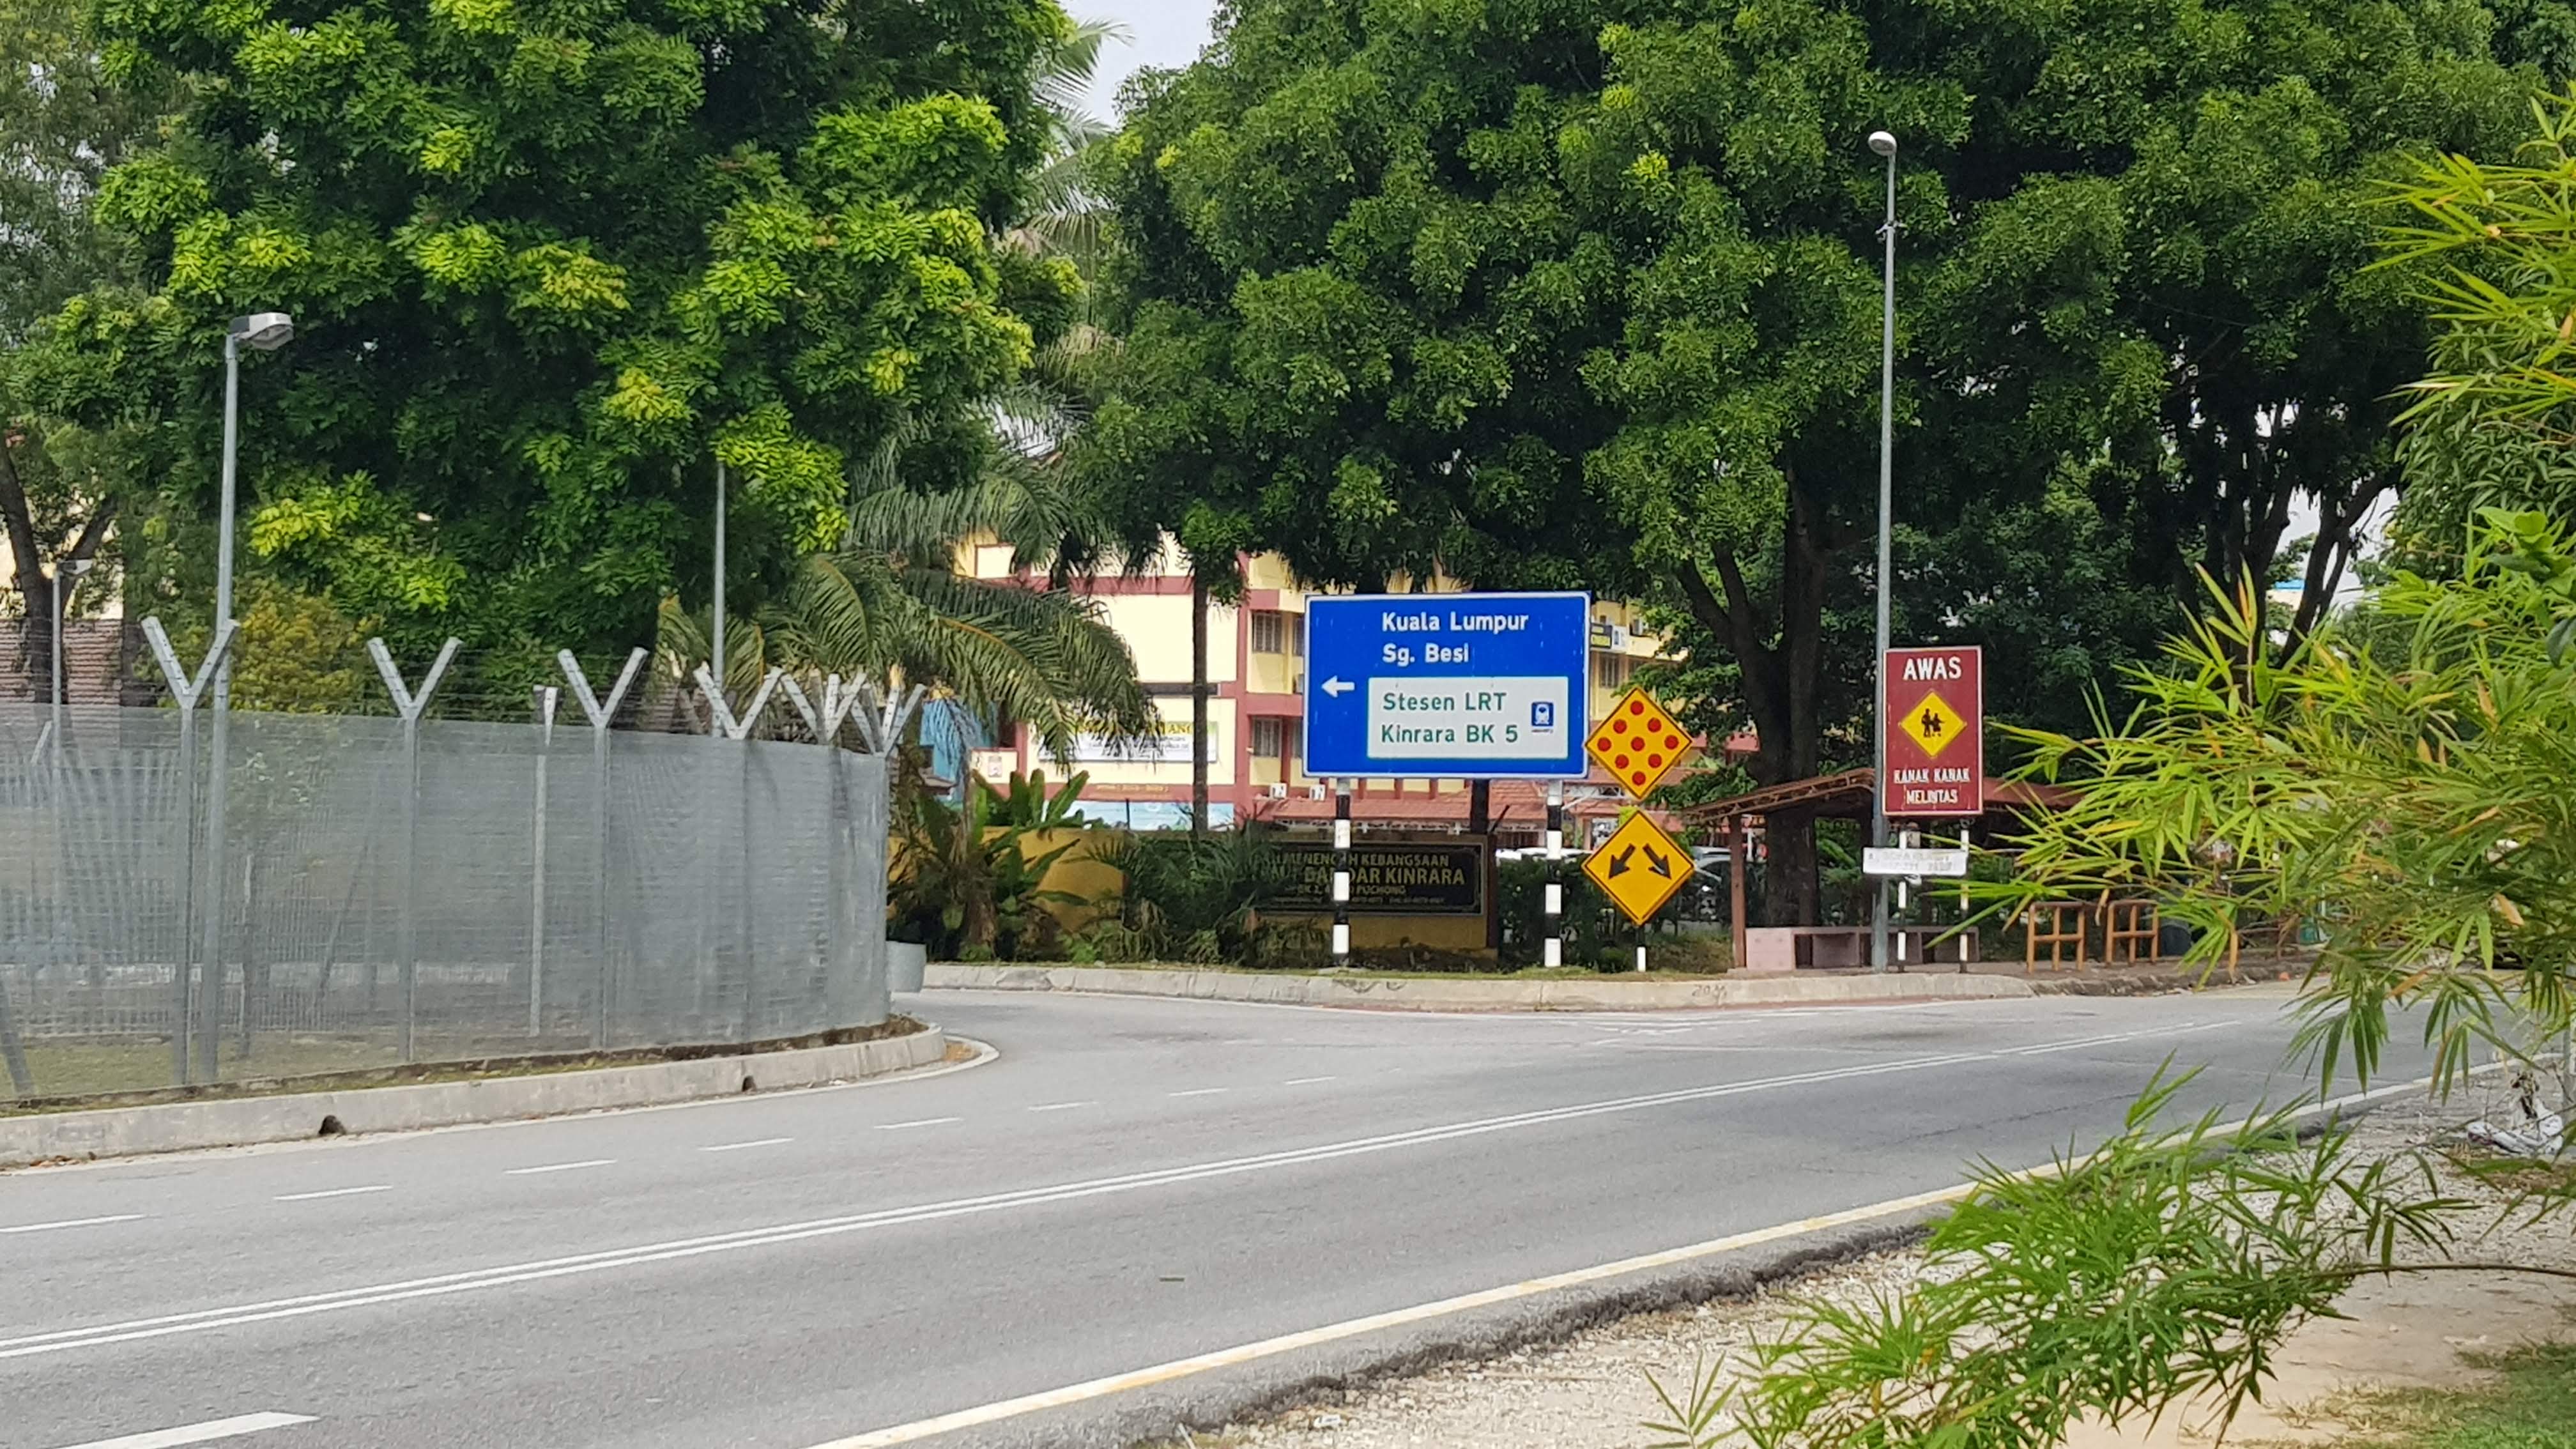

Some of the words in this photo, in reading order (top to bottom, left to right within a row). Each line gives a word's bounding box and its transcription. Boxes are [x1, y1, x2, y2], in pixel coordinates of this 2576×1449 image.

[1382, 611, 1440, 632] Kuala
[1450, 611, 1529, 634] Lumpur
[1382, 643, 1415, 667] Sg.
[1425, 642, 1469, 663] Besi
[1903, 656, 1962, 680] AWAS
[1383, 692, 1455, 711] Stesen
[1465, 692, 1507, 711] LRT
[1381, 724, 1455, 743] Kinrara
[1466, 724, 1495, 743] BK
[1505, 724, 1519, 742] 5
[1893, 769, 1929, 784] KANAK
[1933, 768, 1970, 783] KANAK
[1906, 789, 1958, 804] MELINTAS
[1361, 854, 1449, 867] KEBANGSAAN
[1385, 867, 1466, 885] KINRARA
